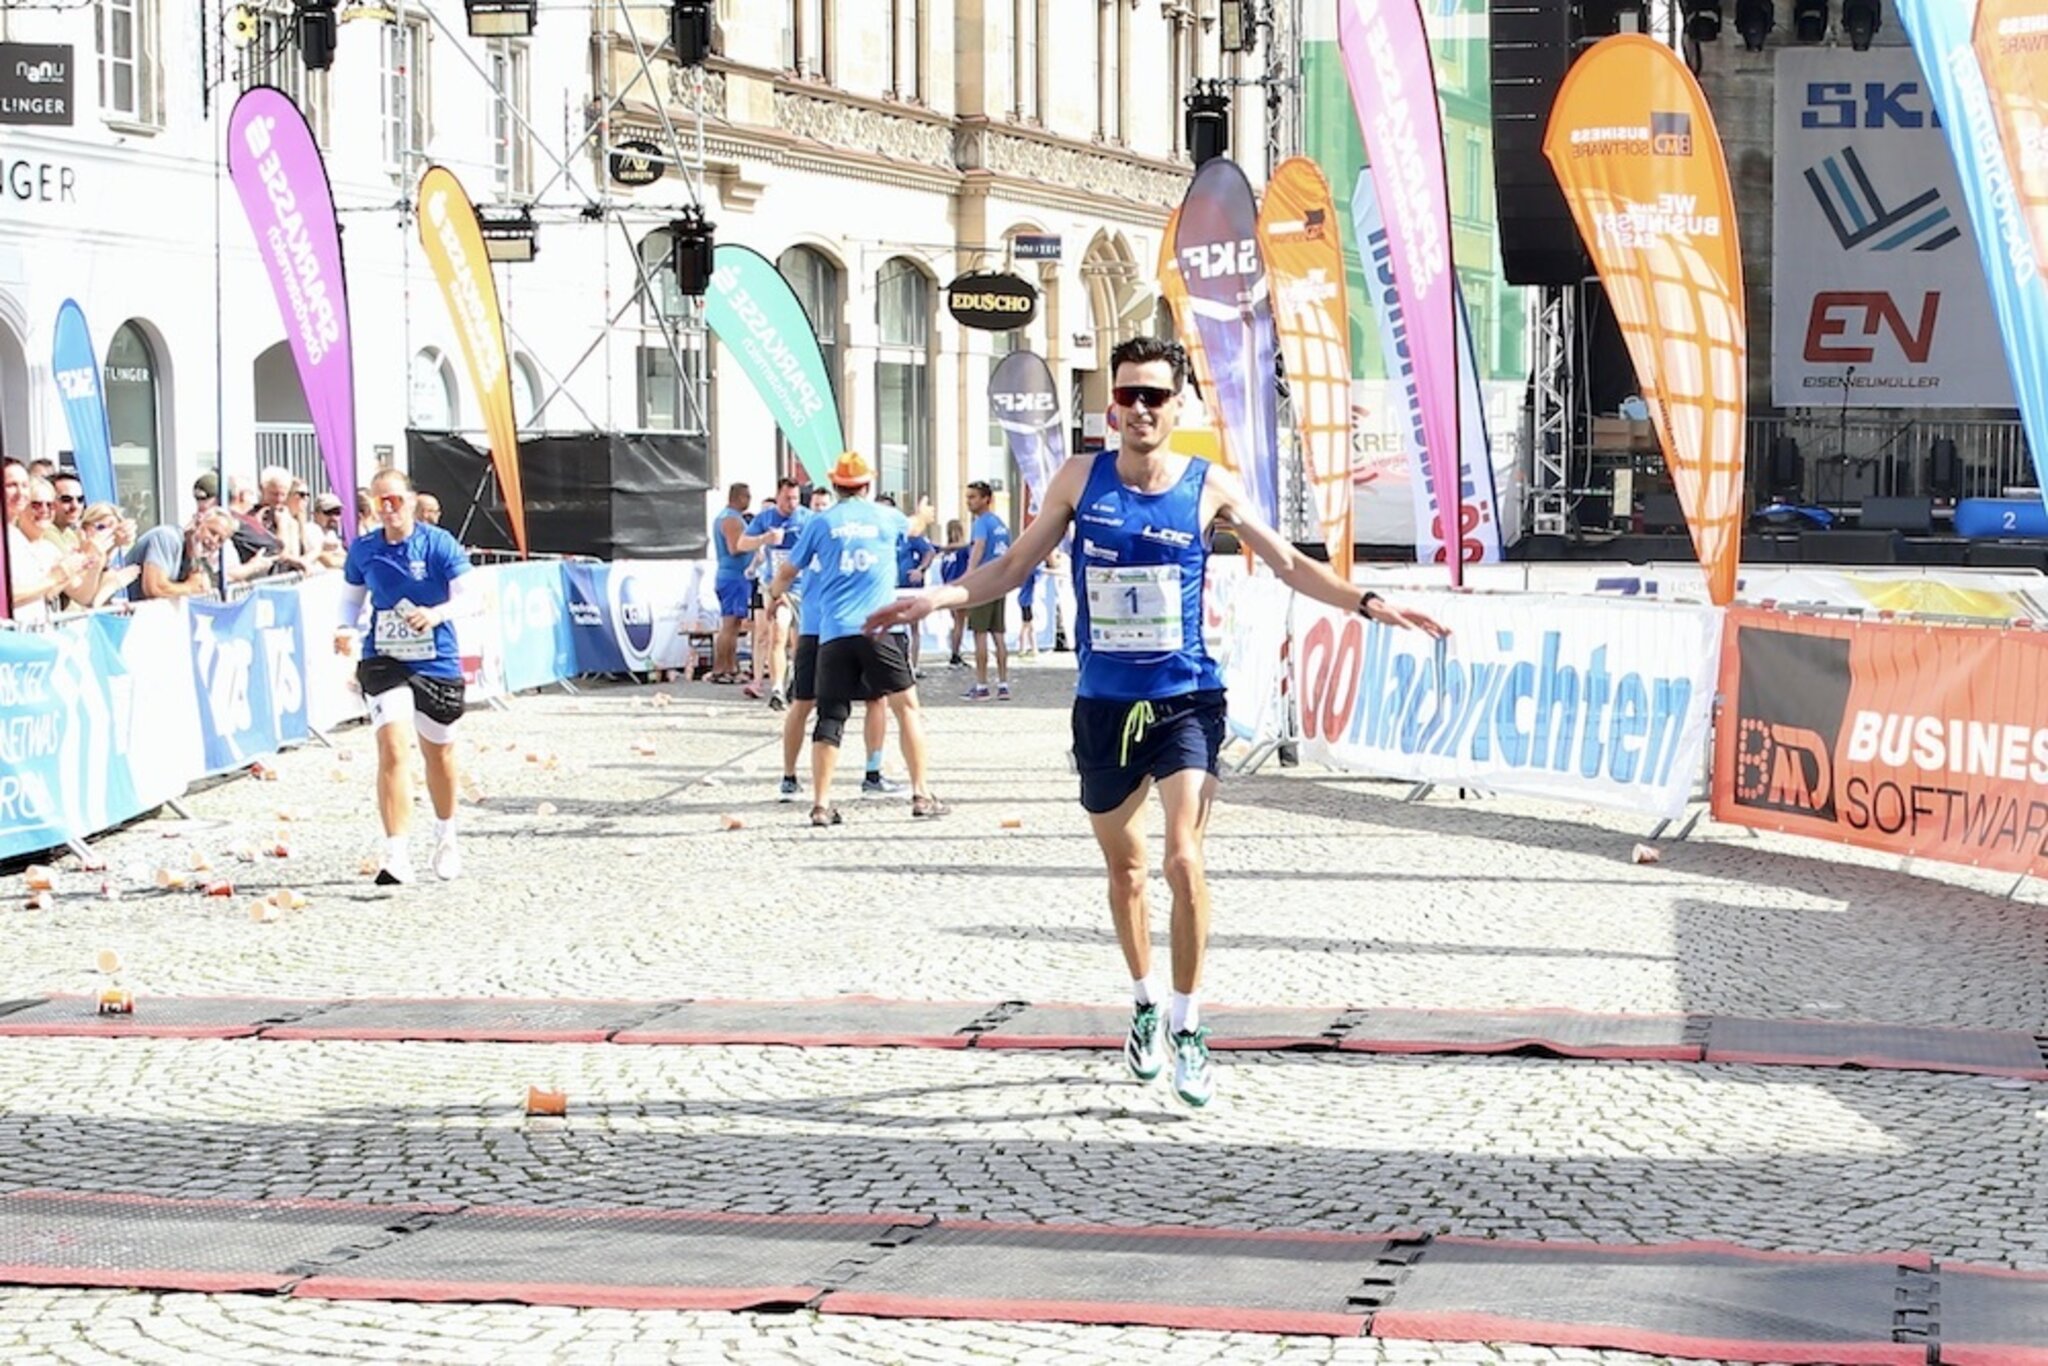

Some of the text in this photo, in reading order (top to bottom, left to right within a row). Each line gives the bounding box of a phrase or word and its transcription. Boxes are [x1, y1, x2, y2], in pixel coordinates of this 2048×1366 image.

[1802, 83, 1942, 128] SK
[951, 292, 1031, 312] EDUSCHO
[2002, 511, 2016, 530] 2
[1124, 586, 1138, 614] 1
